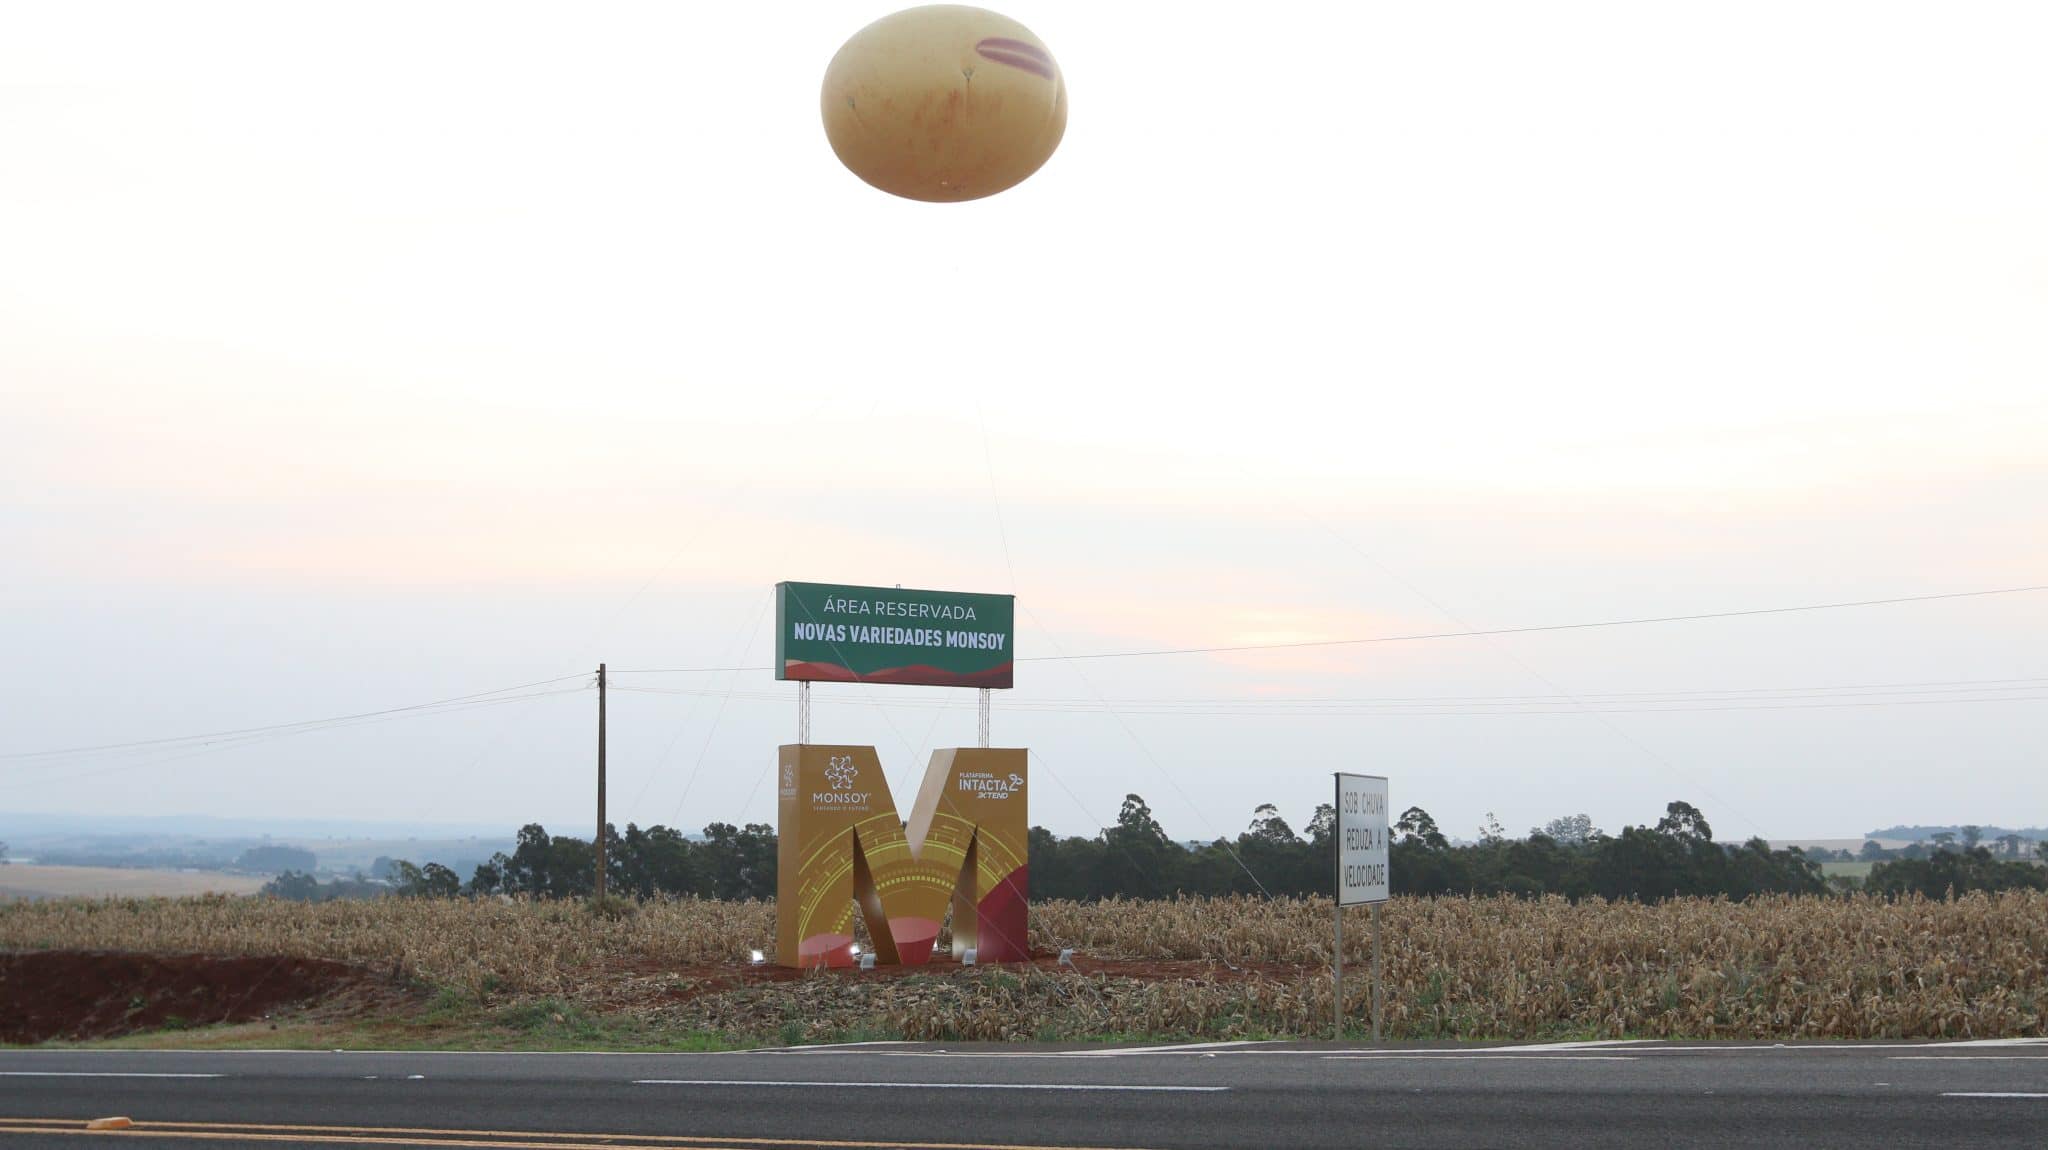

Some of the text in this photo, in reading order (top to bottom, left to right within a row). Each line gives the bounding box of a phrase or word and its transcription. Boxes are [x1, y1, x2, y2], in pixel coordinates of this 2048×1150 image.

[823, 595, 977, 621] ÁREA RESERVADA
[794, 622, 1005, 650] NOVAS VARIEDADES MONSOY
[960, 779, 1007, 791] INTACTA
[813, 793, 868, 803] MONSOY
[1345, 792, 1383, 815] SOB CHUVA
[1346, 829, 1382, 850] REDUZA A
[1344, 864, 1385, 887] VELOCIDADE
